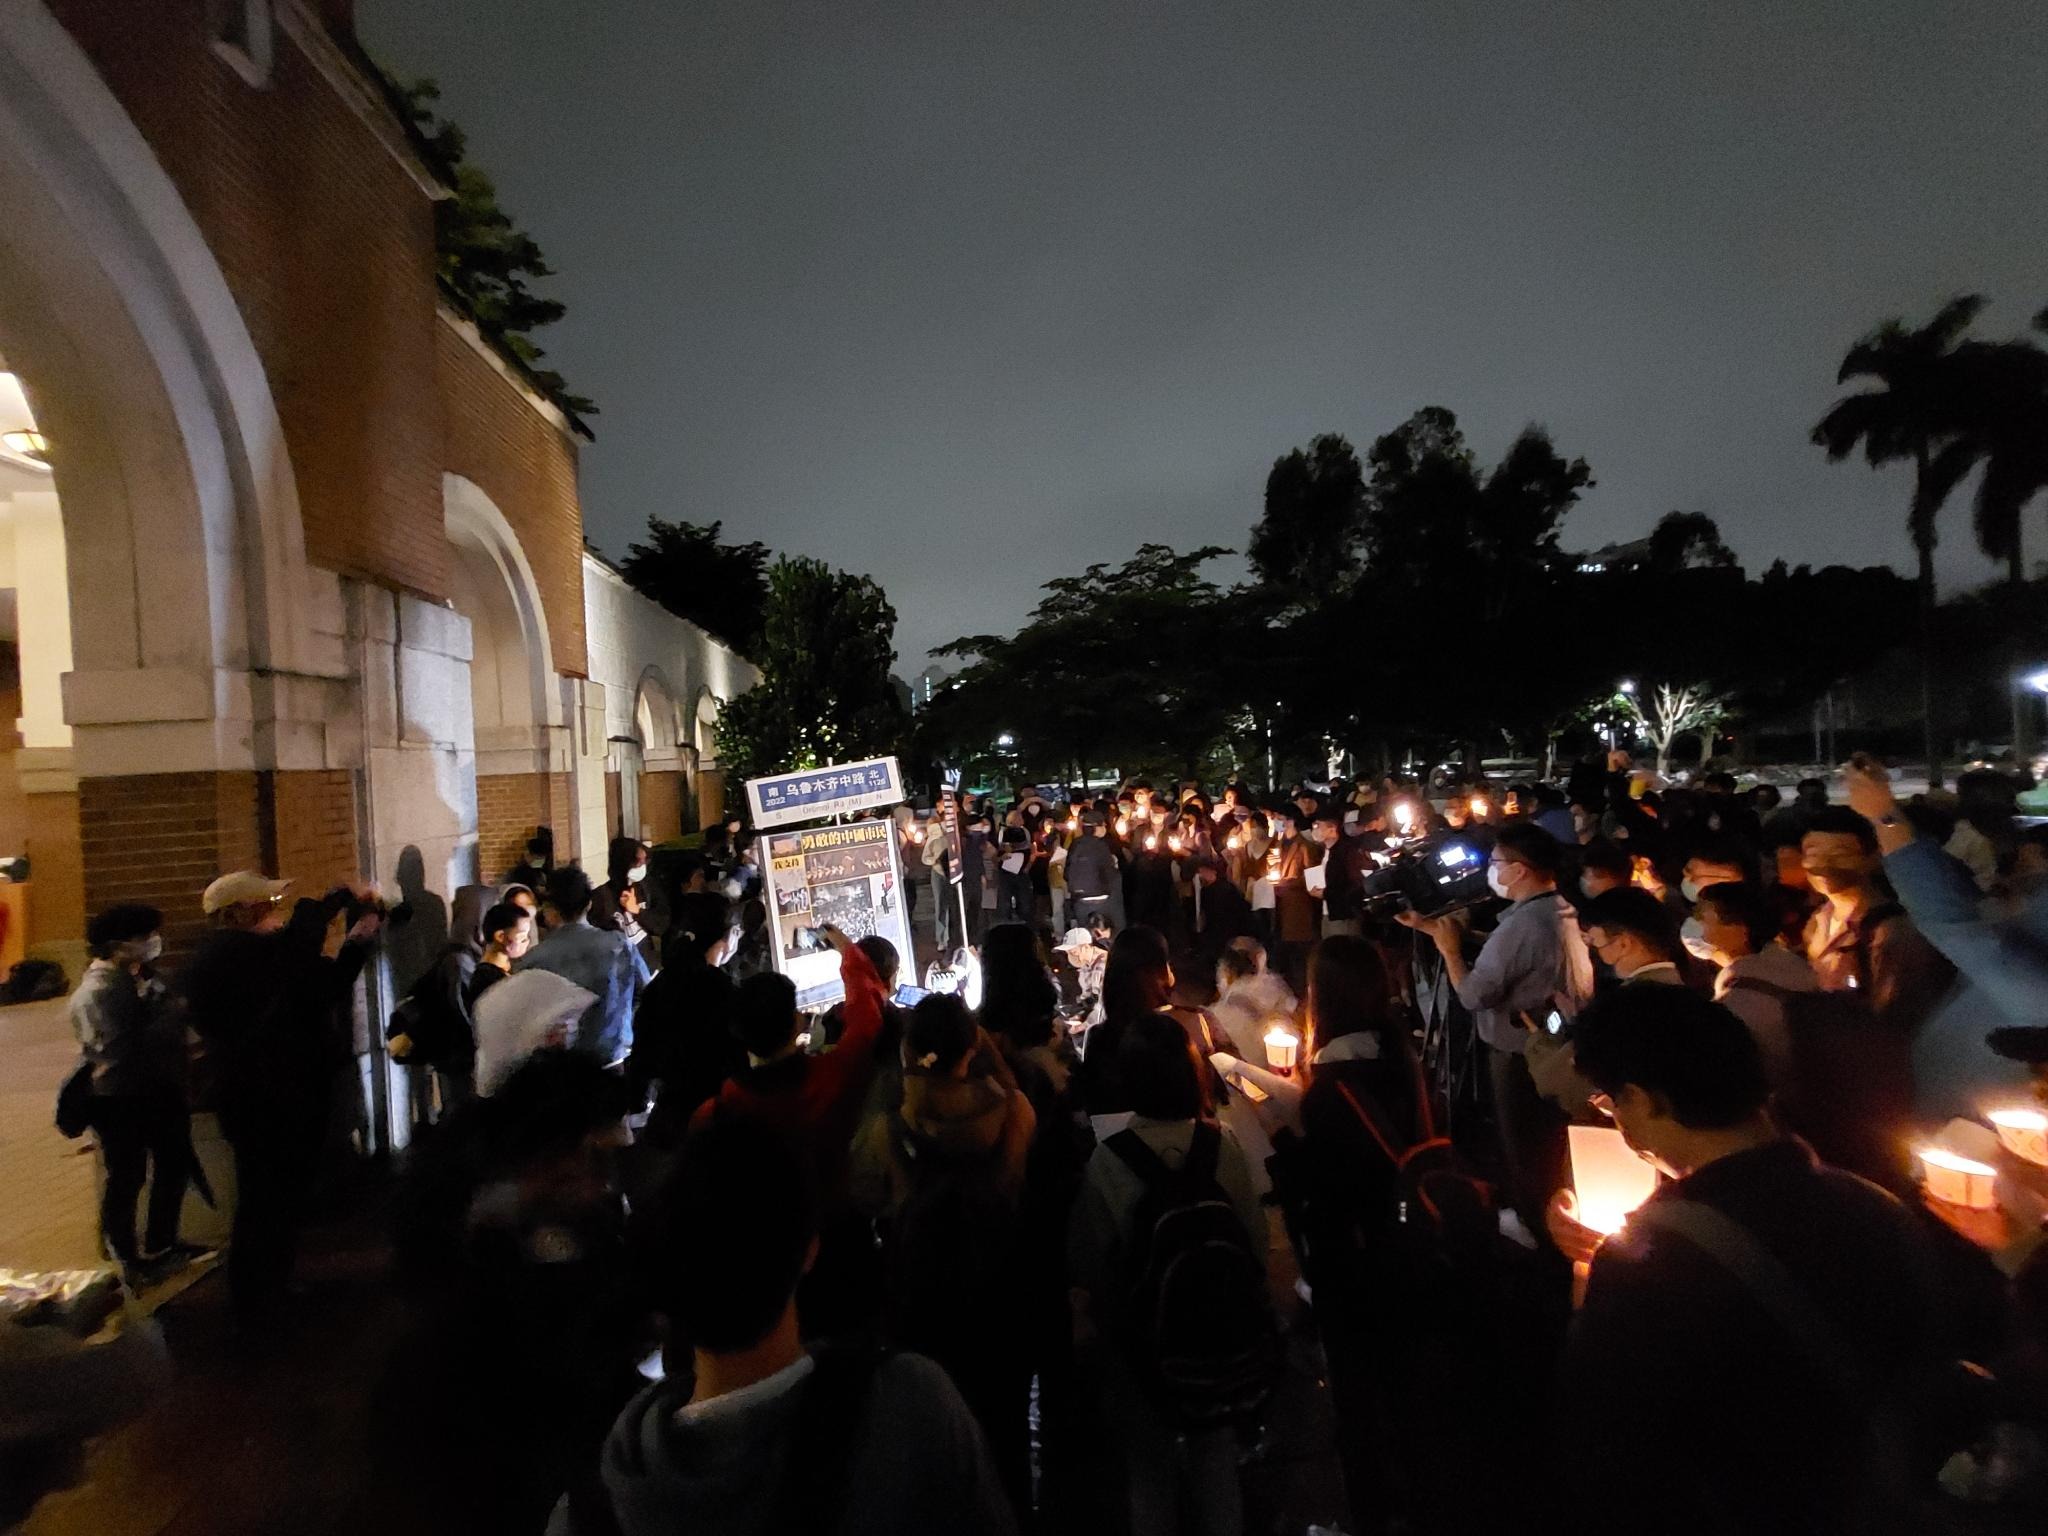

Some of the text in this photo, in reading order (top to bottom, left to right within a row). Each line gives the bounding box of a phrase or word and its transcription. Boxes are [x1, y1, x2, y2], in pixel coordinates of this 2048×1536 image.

[767, 769, 880, 798] 南 乌鲁木齐中路 北
[765, 796, 786, 806] 2022
[775, 812, 783, 820] S
